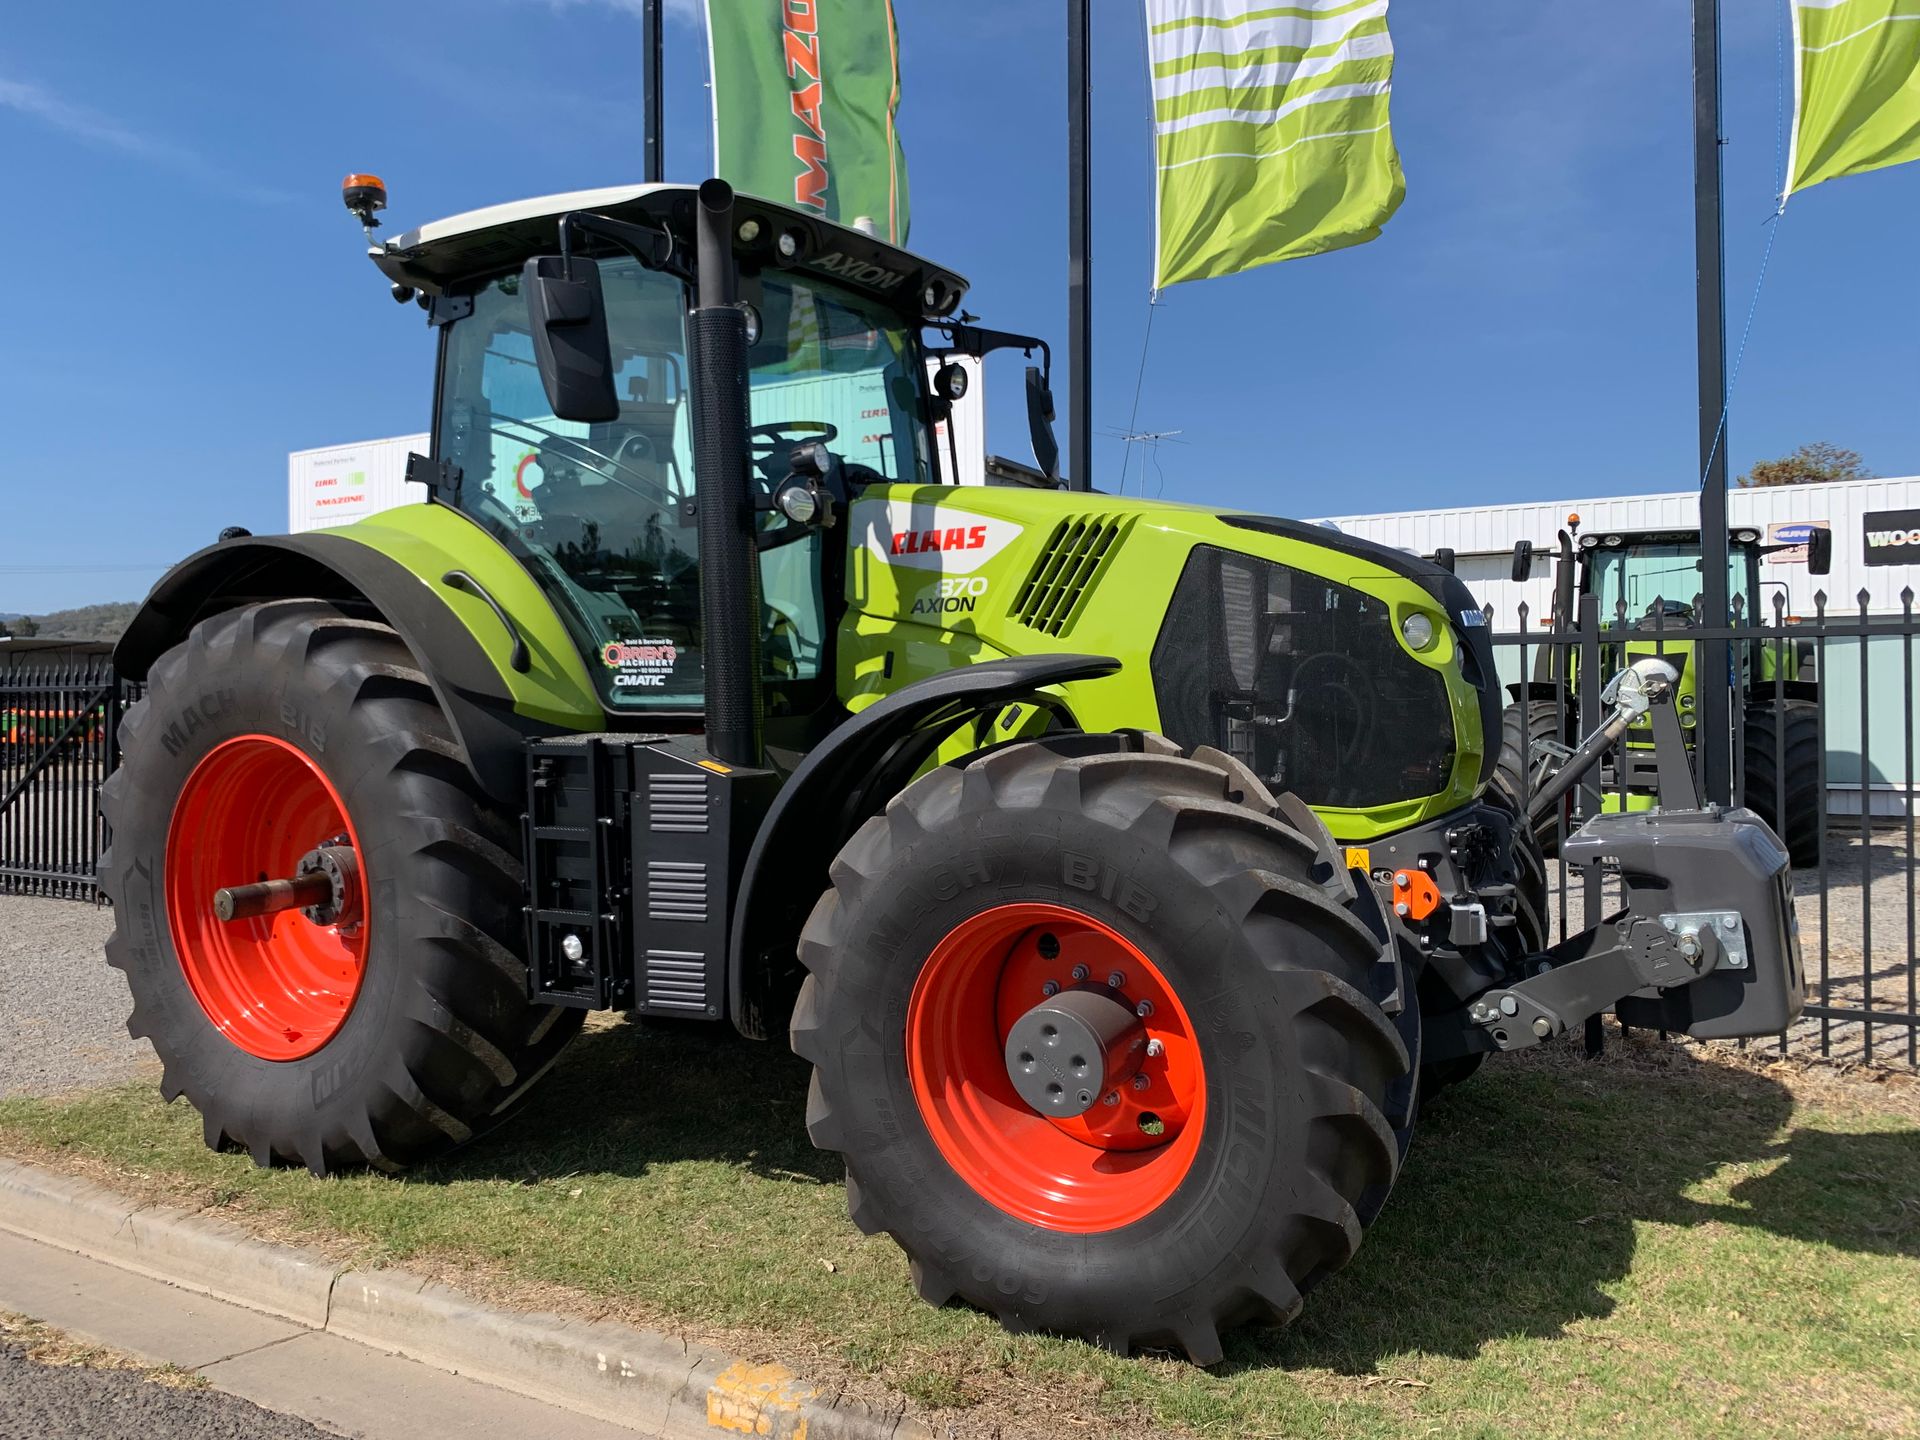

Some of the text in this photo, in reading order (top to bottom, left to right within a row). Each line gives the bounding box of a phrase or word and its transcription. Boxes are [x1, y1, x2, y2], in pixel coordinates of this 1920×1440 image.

[782, 0, 829, 217] MAZO
[810, 252, 904, 289] AXION
[315, 494, 365, 507] AMAZONE
[890, 525, 987, 556] CLAAS
[1641, 533, 1693, 542] ARION
[935, 576, 988, 598] 870
[910, 597, 977, 614] AXION
[619, 659, 675, 667] MACHINERY
[613, 674, 666, 686] CMATIC
[160, 687, 328, 757] MACH BIB
[1061, 850, 1159, 924] BIB
